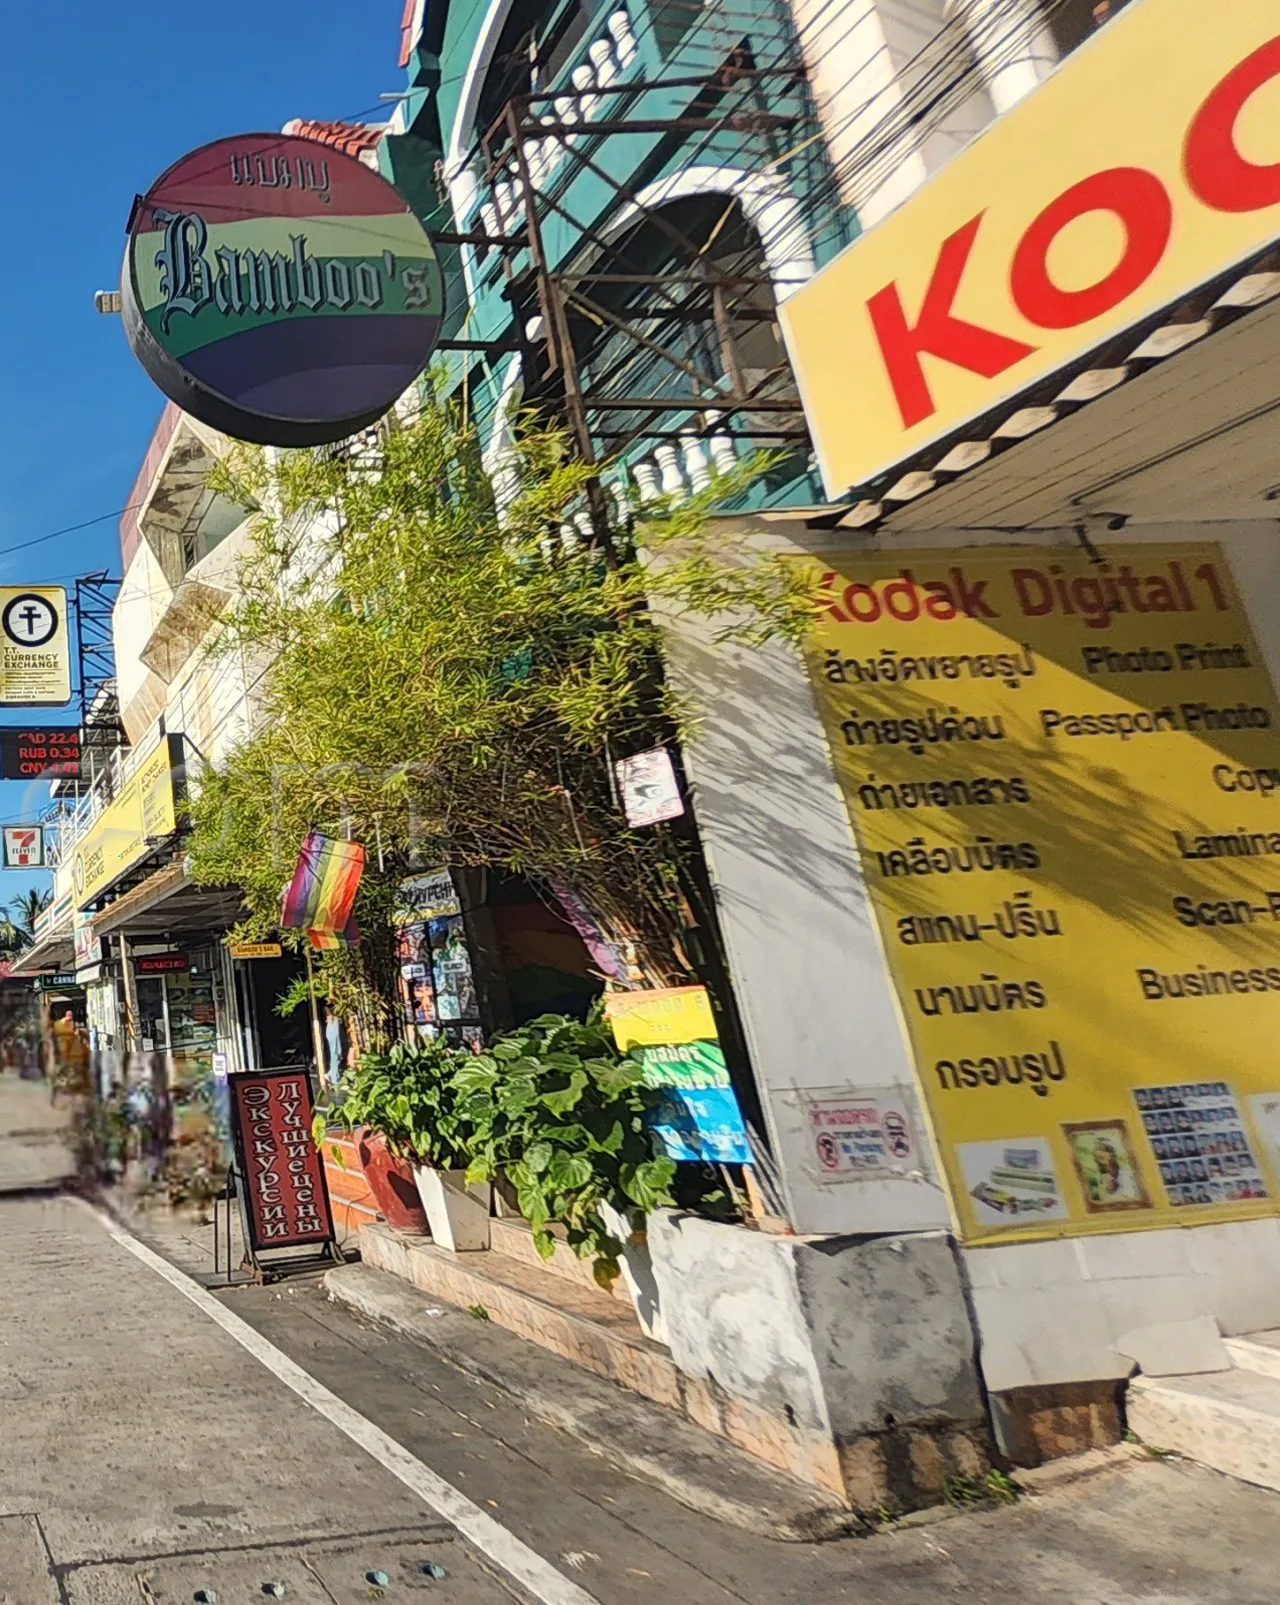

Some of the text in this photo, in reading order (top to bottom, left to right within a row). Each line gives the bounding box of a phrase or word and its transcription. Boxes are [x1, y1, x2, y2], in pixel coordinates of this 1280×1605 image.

[152, 207, 434, 335] Bamboo's
[814, 560, 1230, 629] Kodak Digital 1
[4, 653, 59, 661] CURRENCY
[4, 660, 60, 669] EXCHANGE
[1081, 642, 1253, 674] Photo Print
[840, 705, 1007, 756] ถ่ายรูปด่วน
[1038, 701, 1271, 741] Passport Photo
[19, 747, 47, 759] RUB
[19, 762, 47, 774] CNY
[857, 773, 1032, 811] ถ่ายเอกสาร
[875, 835, 1041, 878] เคลือบบัตร
[913, 972, 1049, 1017] นามบัตร
[1135, 963, 1280, 1001] Business
[934, 1040, 1067, 1098] กรอบรูป
